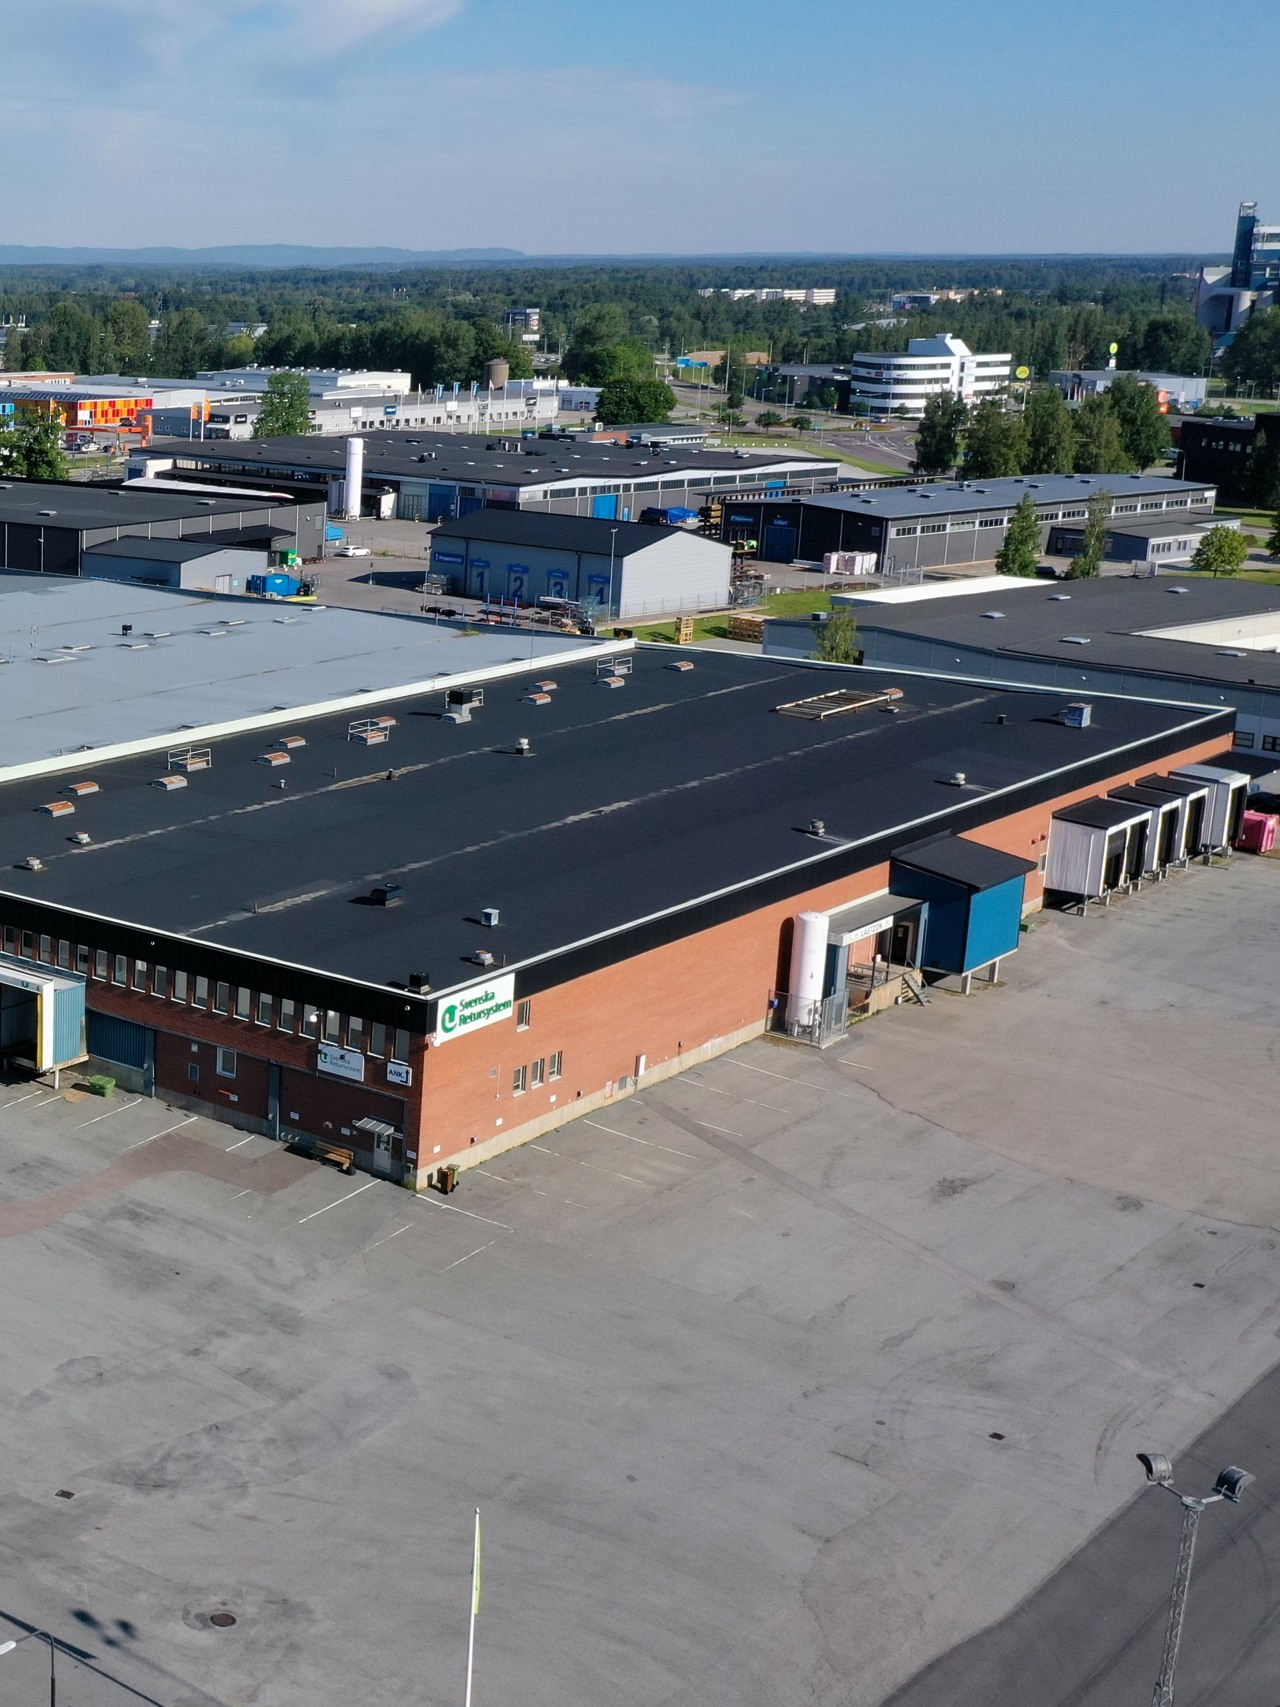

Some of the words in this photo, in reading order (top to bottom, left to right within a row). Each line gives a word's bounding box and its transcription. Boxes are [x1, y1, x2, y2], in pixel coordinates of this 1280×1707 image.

[476, 571, 484, 593] 1
[512, 576, 524, 599] 2
[553, 581, 564, 598] 3
[459, 990, 495, 1012] Svenska
[458, 1000, 512, 1027] Retursystem
[329, 1059, 361, 1072] Retursystem
[388, 1069, 405, 1079] ANK.
